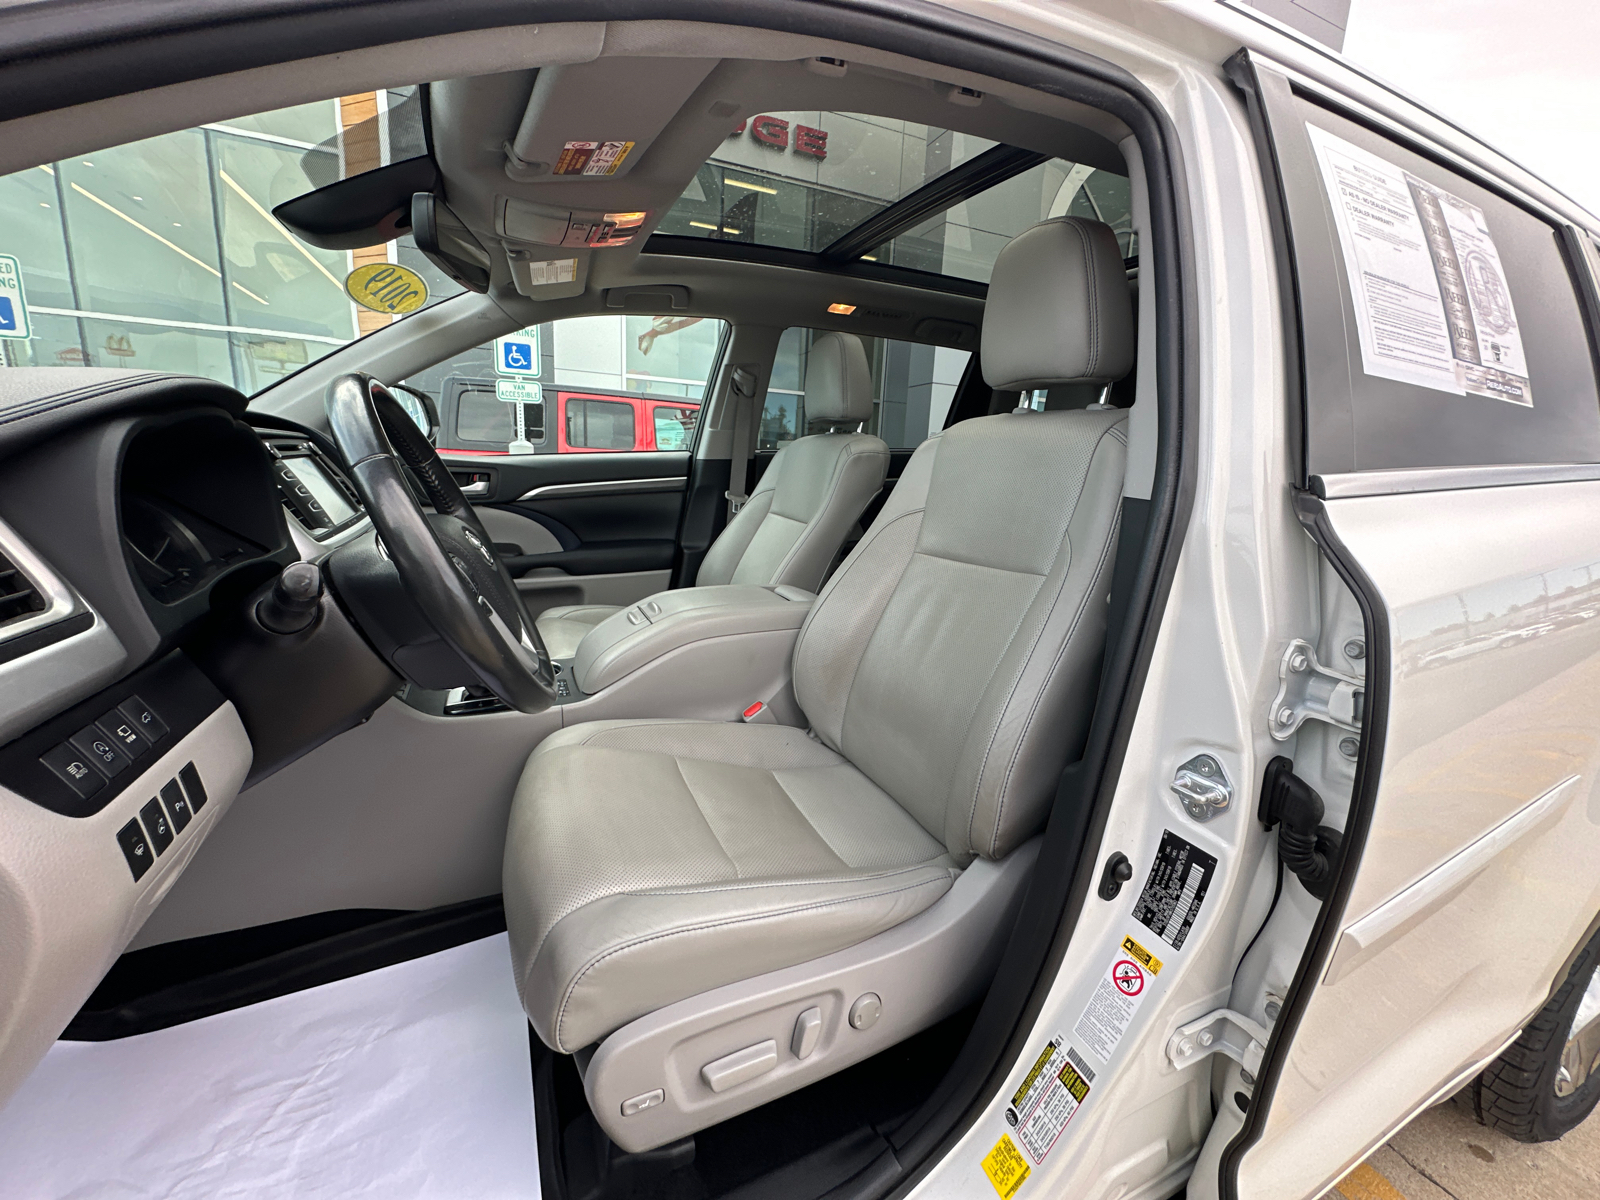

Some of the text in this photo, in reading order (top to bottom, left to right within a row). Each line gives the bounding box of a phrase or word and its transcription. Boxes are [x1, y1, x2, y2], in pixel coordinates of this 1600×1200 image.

[1352, 206, 1394, 227] DEALER WARRANTY
[1370, 200, 1386, 212] DEALER
[1387, 208, 1409, 221] WARRANTY
[1444, 285, 1466, 307] REED
[1452, 322, 1475, 342] REED
[500, 390, 538, 399] ACCESSIBLE
